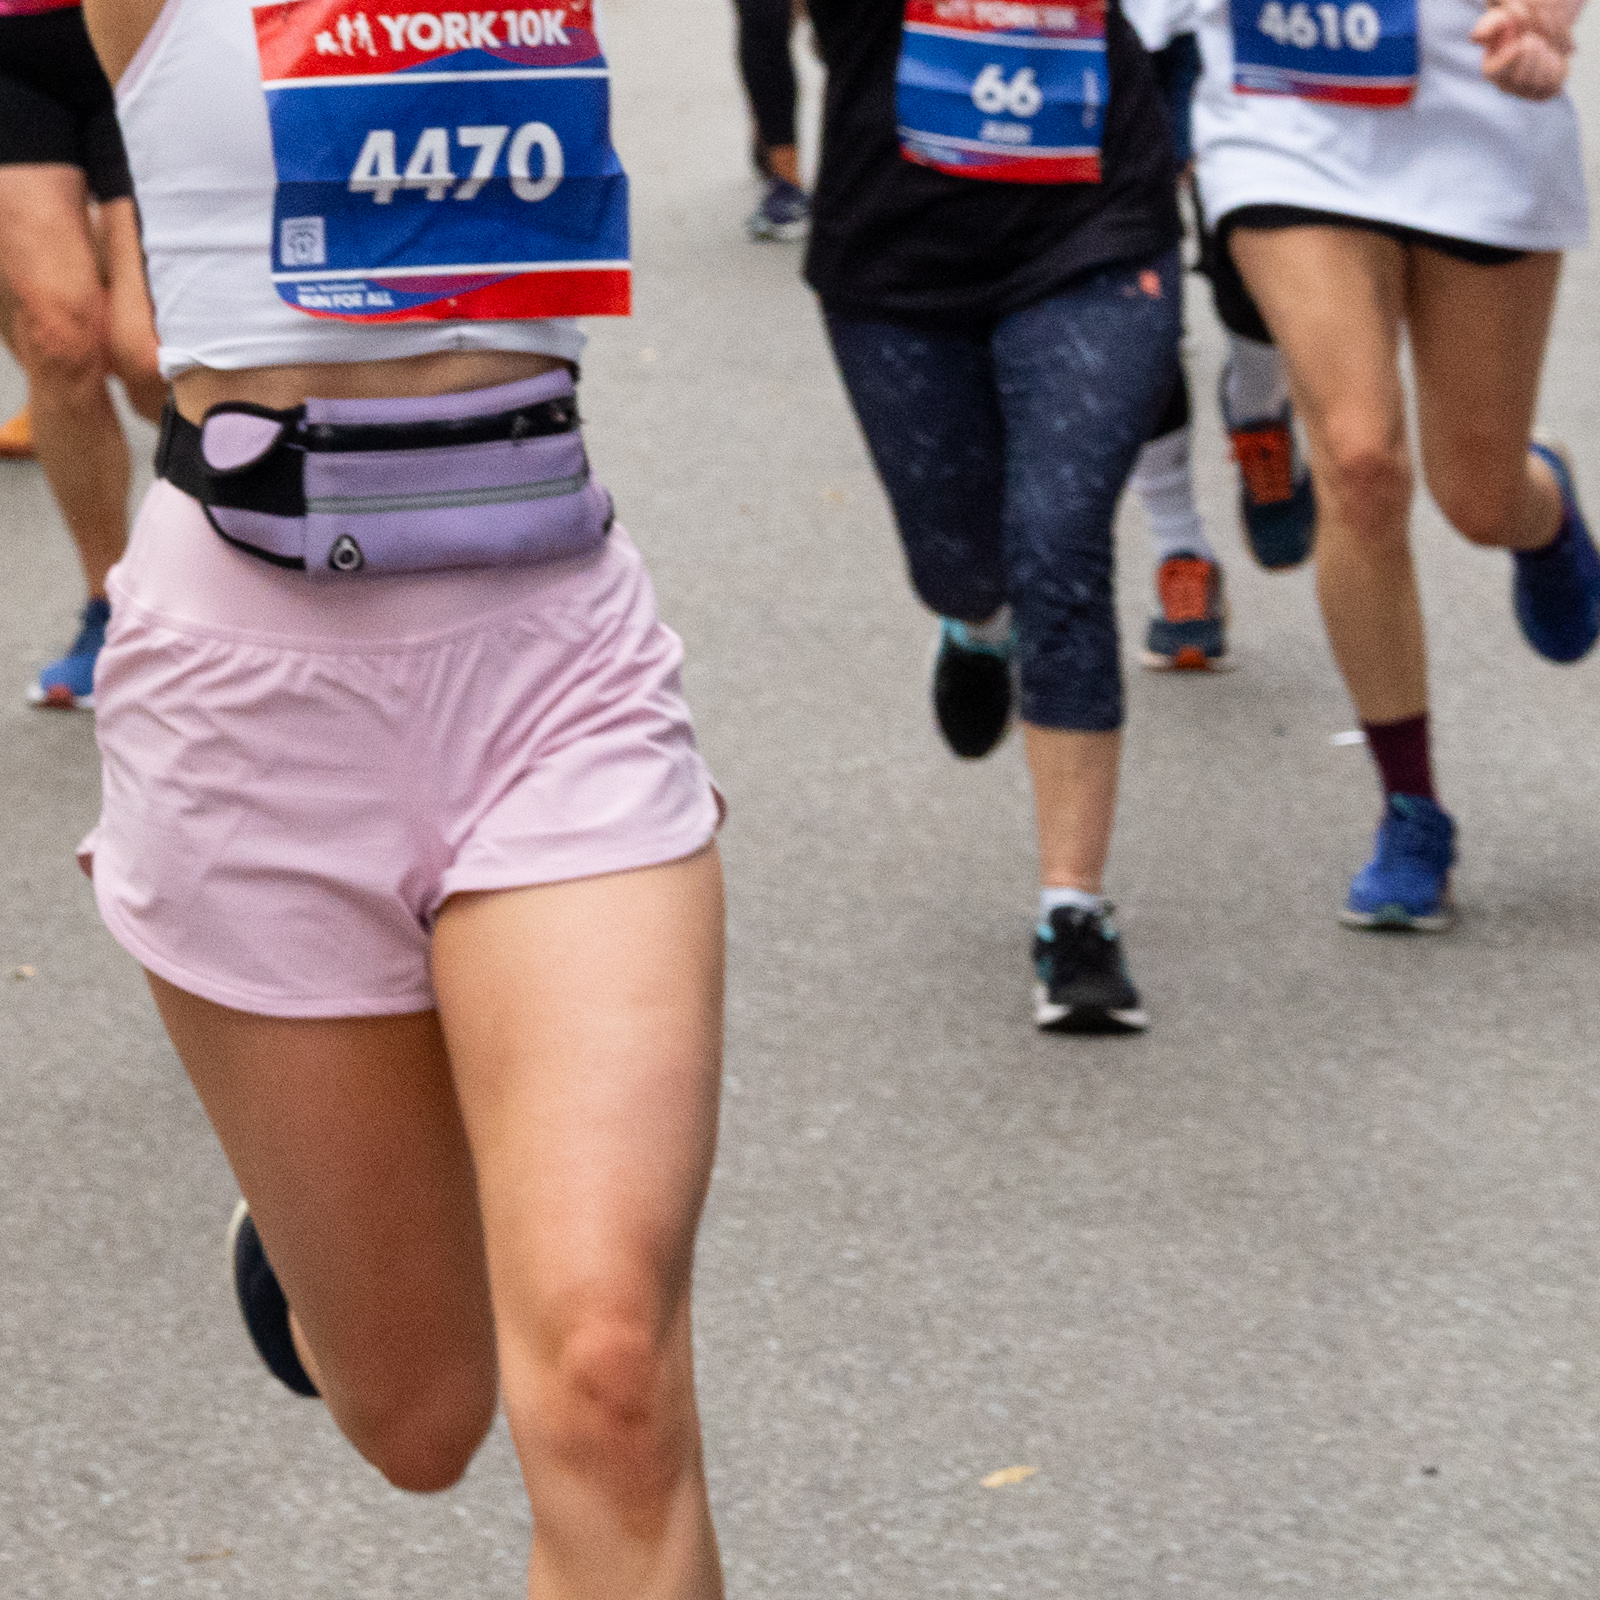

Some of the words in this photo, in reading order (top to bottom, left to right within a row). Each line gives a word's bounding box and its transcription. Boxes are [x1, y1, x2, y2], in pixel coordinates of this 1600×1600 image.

[377, 11, 504, 52] YORK
[504, 9, 571, 48] 10K
[1257, 1, 1382, 52] 4610
[970, 62, 1044, 119] 66
[347, 121, 565, 205] 4470
